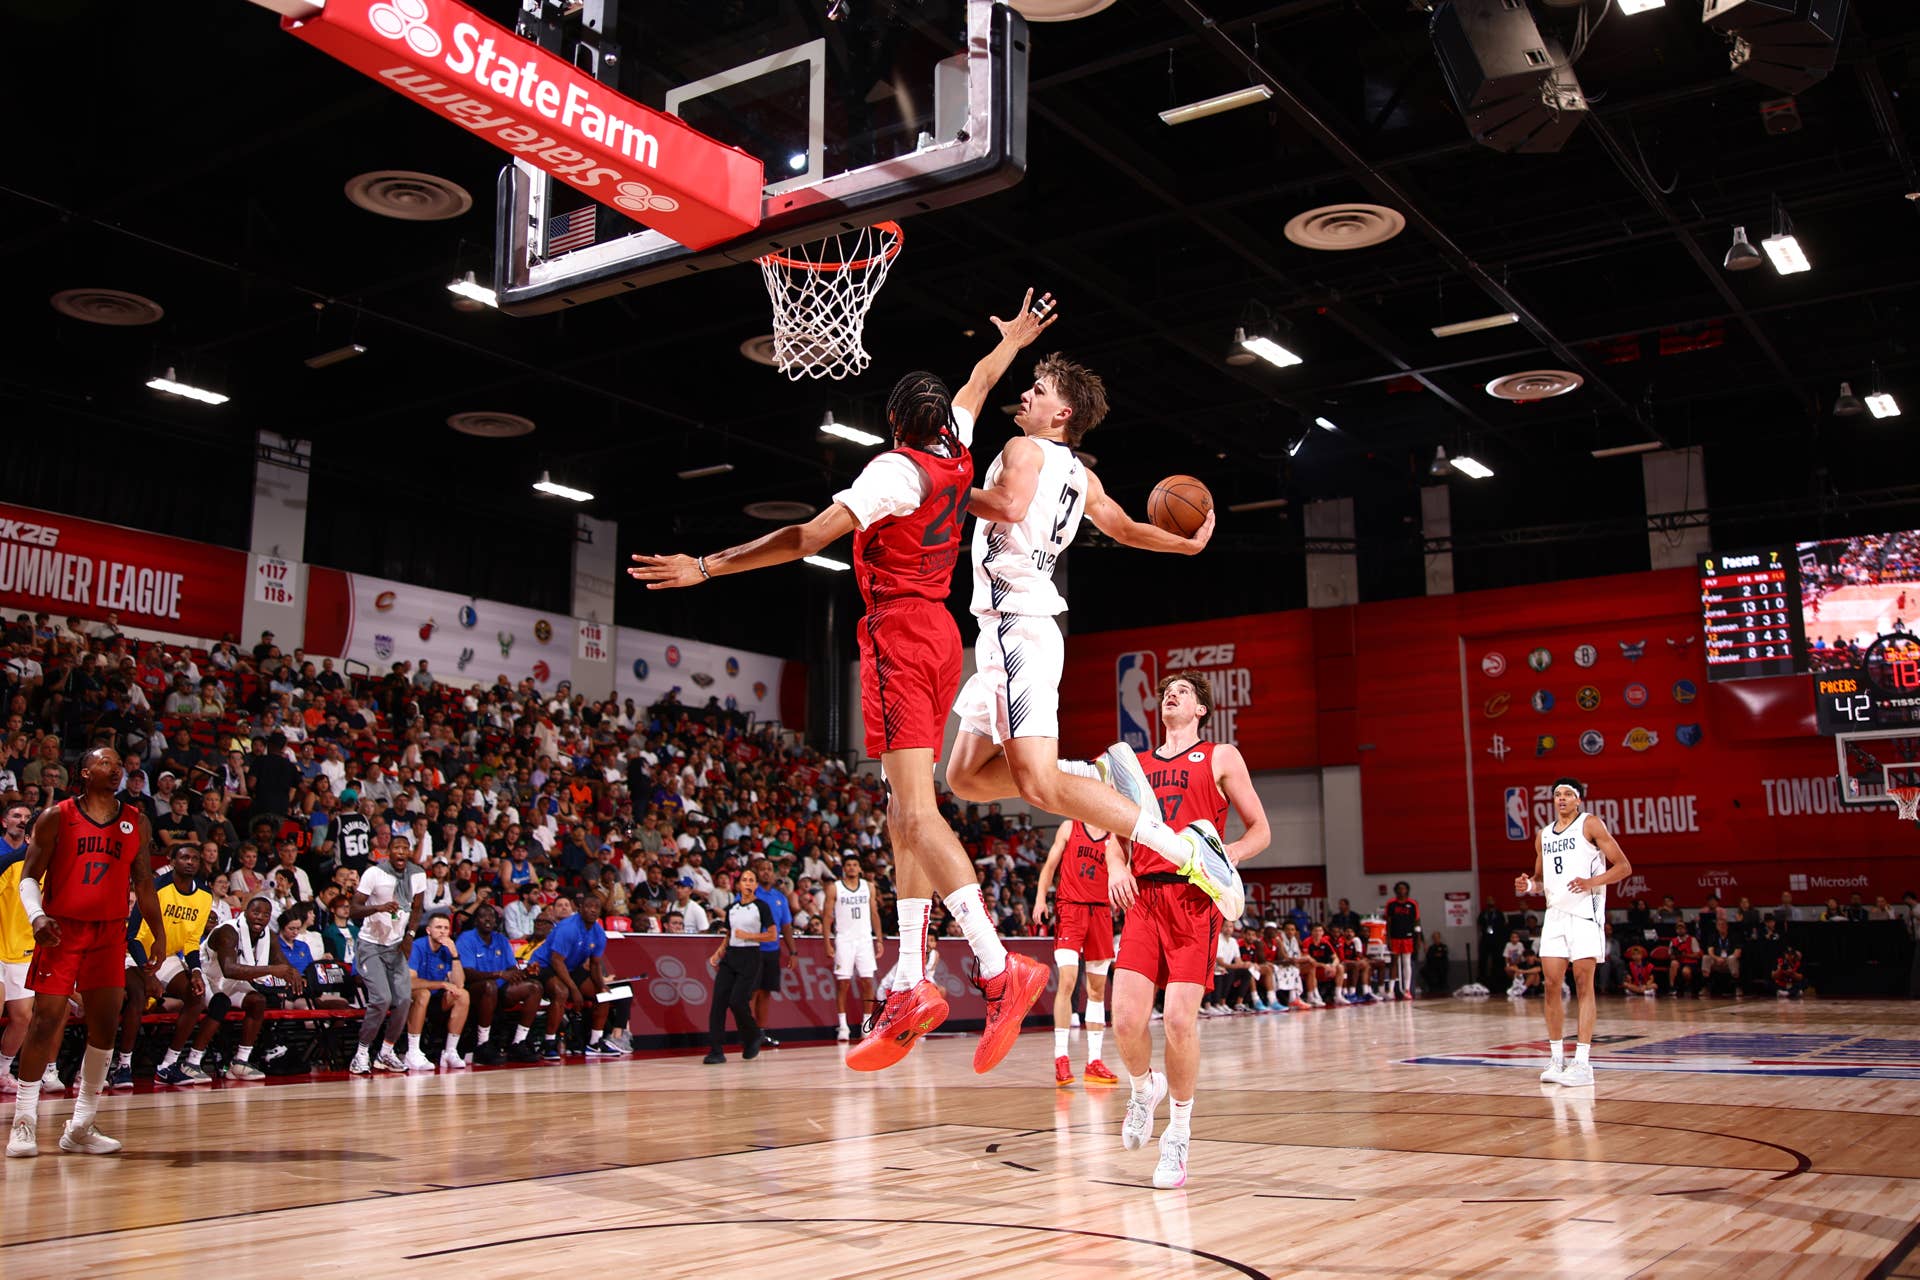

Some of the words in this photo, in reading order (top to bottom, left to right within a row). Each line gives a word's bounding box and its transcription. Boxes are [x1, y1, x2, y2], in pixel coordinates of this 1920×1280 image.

[1722, 555, 1760, 569] Pacers
[0, 541, 93, 605] UMMER
[96, 560, 184, 619] LEAGUE
[266, 563, 288, 580] 117
[265, 586, 285, 603] 118
[1743, 585, 1752, 597] 2
[1759, 583, 1768, 595] 0
[1775, 582, 1782, 593] 1
[1742, 601, 1757, 613] 13
[1763, 600, 1769, 610] 1
[1775, 597, 1785, 609] 0
[1745, 616, 1754, 627] 2
[1762, 614, 1771, 626] 3
[1777, 613, 1786, 624] 3
[1746, 631, 1756, 643] 9
[1763, 630, 1772, 641] 4
[1779, 629, 1787, 640] 3
[1166, 643, 1235, 670] 2K26
[1748, 647, 1757, 658] 8
[1765, 645, 1775, 657] 2
[1782, 644, 1789, 655] 1
[1203, 668, 1252, 707] MER
[1820, 679, 1858, 695] PACERS
[1834, 694, 1870, 721] 42
[1890, 697, 1920, 707] TISSO
[1533, 799, 1619, 836] SUER
[1623, 795, 1700, 835] LEAGUE
[77, 836, 122, 860] BULLS
[344, 833, 369, 857] 50
[1543, 837, 1576, 856] PACERS
[1077, 845, 1105, 864] BULLS
[81, 861, 110, 885] 17
[1079, 862, 1096, 880] 14
[1554, 856, 1563, 875] 8
[1269, 882, 1313, 897] 2K26
[1698, 877, 1738, 887] ULTRA
[1810, 874, 1868, 888] Microsoft
[840, 895, 867, 905] PACERS
[164, 903, 199, 921] PACERS
[851, 907, 861, 920] 10
